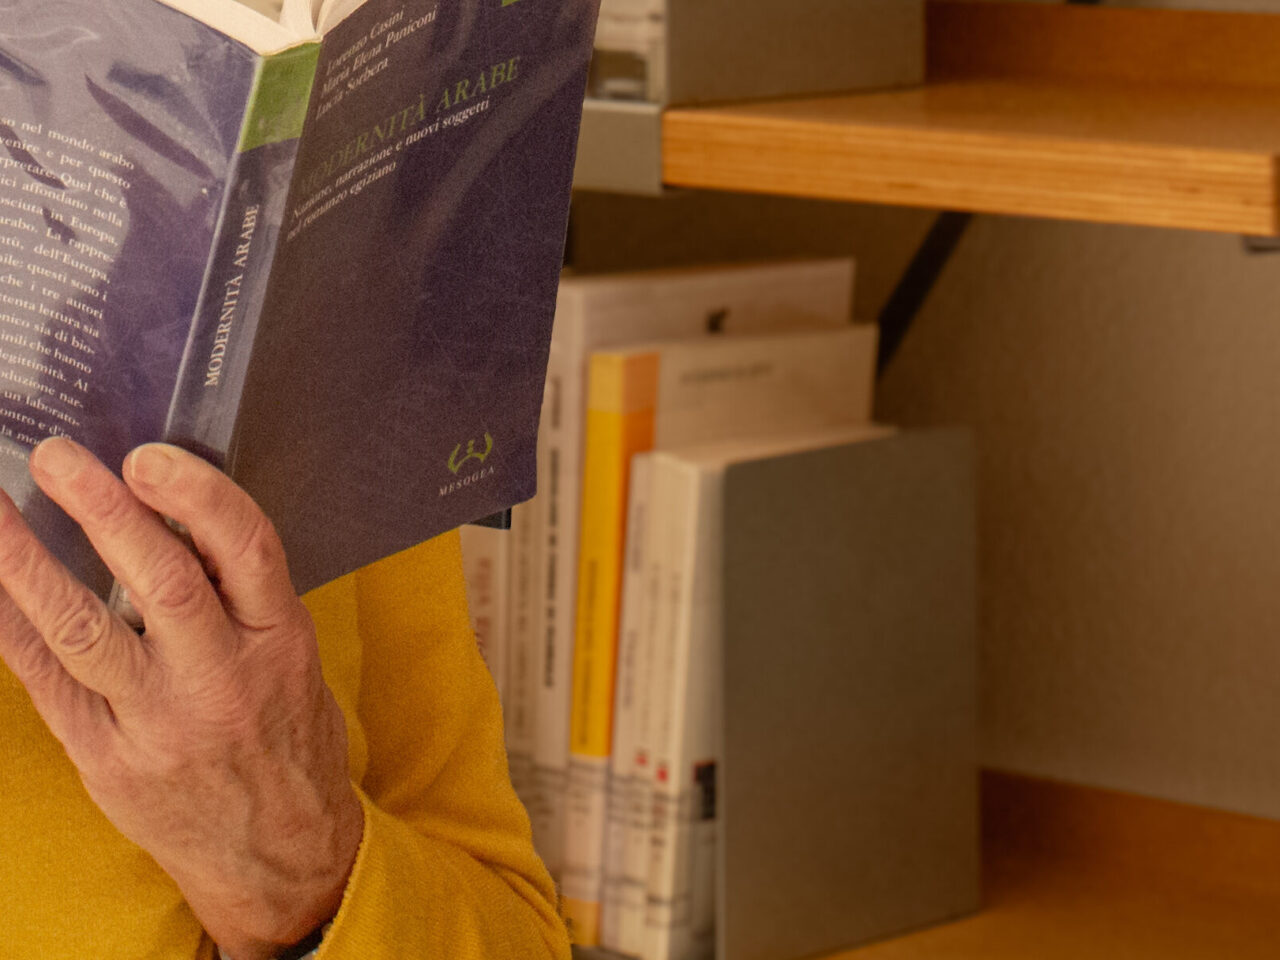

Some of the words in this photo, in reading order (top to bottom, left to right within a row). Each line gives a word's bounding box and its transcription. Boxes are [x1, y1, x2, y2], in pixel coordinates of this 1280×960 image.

[352, 43, 383, 72] Elena
[385, 4, 438, 49] Paniconi
[370, 4, 406, 39] Casini
[346, 57, 389, 91] Sorbera
[435, 56, 520, 114] ARABE
[21, 121, 42, 135] nel
[47, 129, 95, 152] mondo
[99, 149, 135, 171] arabo
[335, 146, 393, 188] narrazione
[395, 141, 403, 152] e
[405, 118, 440, 146] nuovi
[442, 95, 490, 128] soggetti
[46, 150, 55, 159] e
[60, 154, 83, 168] per
[88, 165, 130, 189] questo
[349, 161, 397, 196] egiziano
[22, 182, 88, 211] affondano
[93, 206, 122, 228] nella
[61, 172, 92, 193] Quel
[95, 187, 117, 204] che
[46, 227, 61, 241] La
[49, 207, 64, 221] in
[70, 215, 119, 247] Europa,
[0, 273, 24, 289] che
[41, 287, 60, 300] tre
[66, 298, 104, 320] autori
[26, 263, 67, 283] questi
[71, 279, 100, 298] sono
[204, 273, 243, 387] MODERNITÀ
[233, 204, 260, 268] ARABE
[38, 302, 81, 330] lettura
[82, 324, 100, 339] sia
[33, 322, 52, 338] sia
[54, 329, 68, 344] di
[71, 335, 96, 355] bio-
[29, 340, 53, 357] che
[54, 347, 93, 376] hanno
[59, 391, 84, 409] nar-
[74, 377, 90, 394] Al
[4, 390, 22, 402] un
[25, 395, 81, 427] laborato-
[38, 420, 47, 431] e
[0, 424, 13, 438] la
[439, 465, 495, 497] MESOGEA
